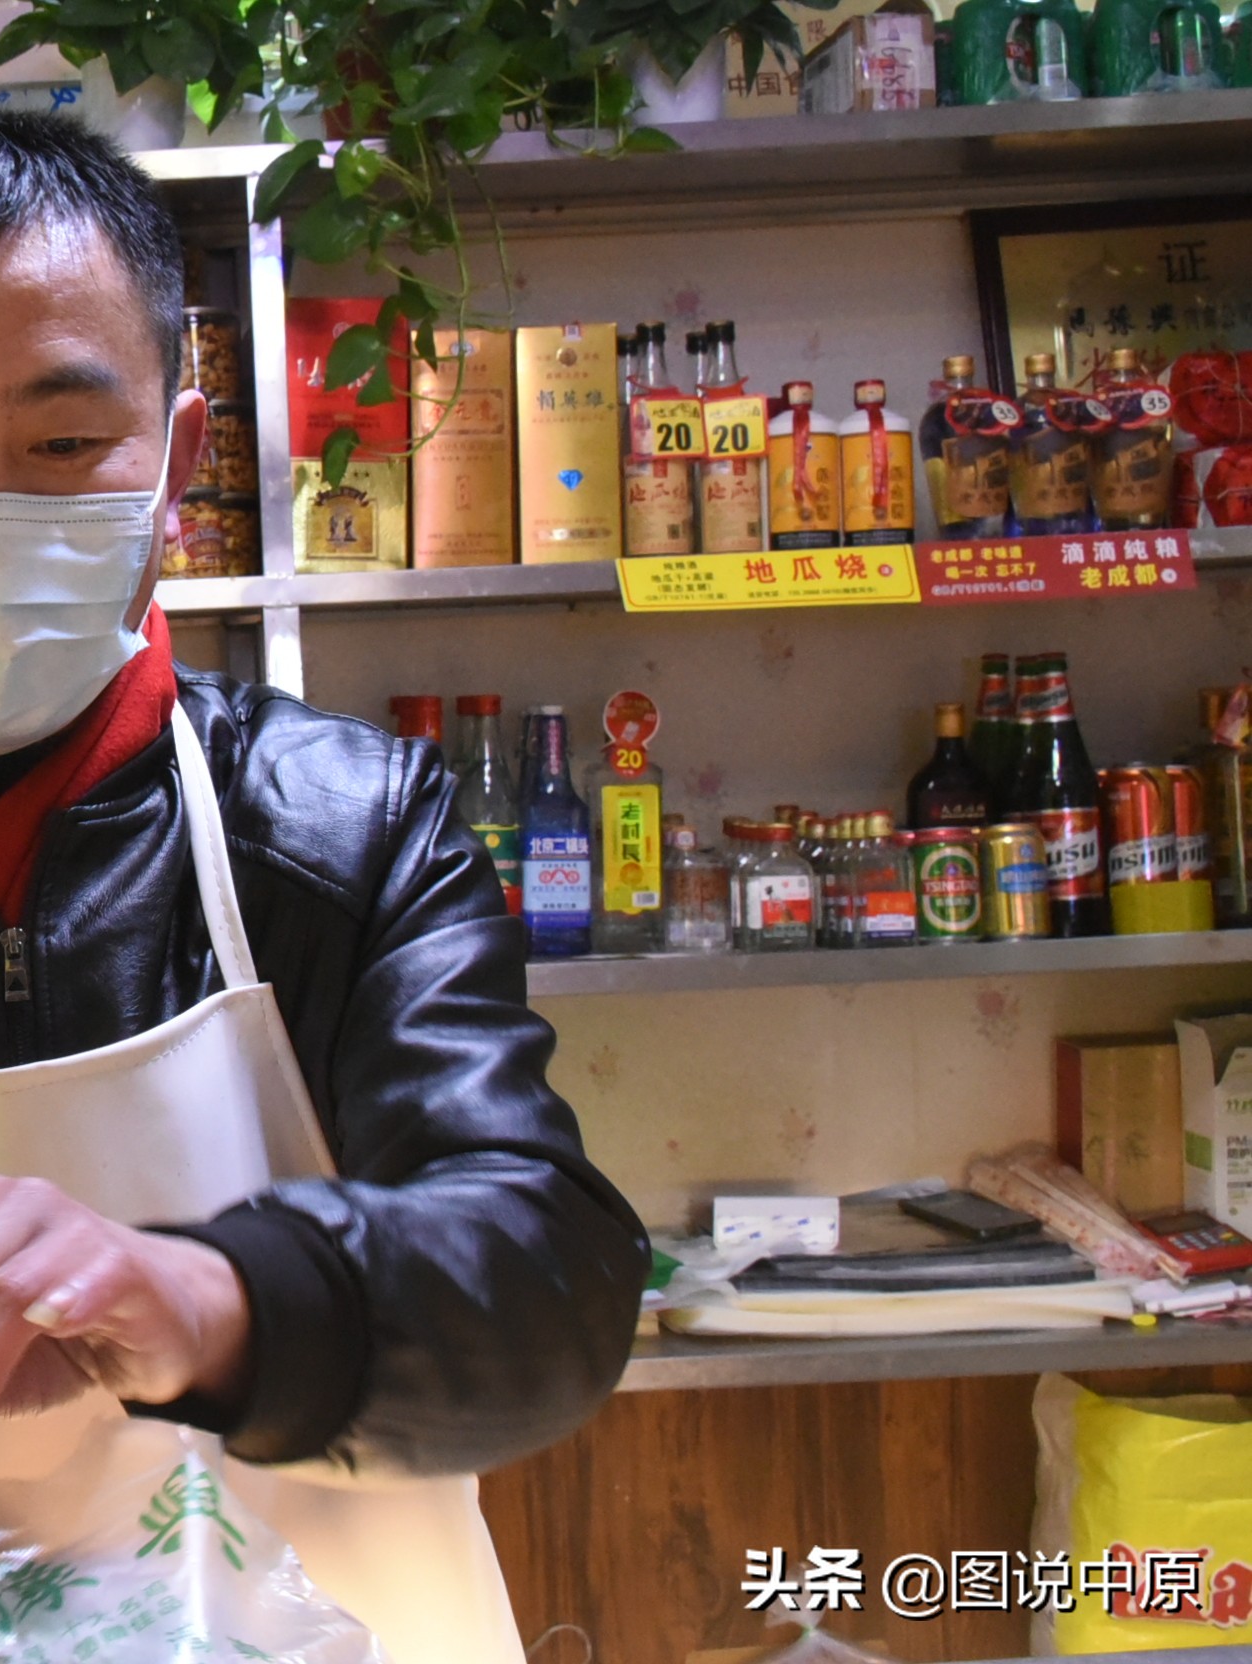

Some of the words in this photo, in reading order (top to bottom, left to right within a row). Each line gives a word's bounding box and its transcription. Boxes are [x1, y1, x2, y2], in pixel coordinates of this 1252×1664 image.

[1146, 396, 1169, 411] 35
[656, 422, 692, 452] 20
[712, 422, 749, 453] 20
[1060, 537, 1180, 565] 滴滴纯粮
[743, 553, 868, 584] 地瓜烧
[1079, 563, 1158, 590] 老成都
[616, 749, 643, 768] 20
